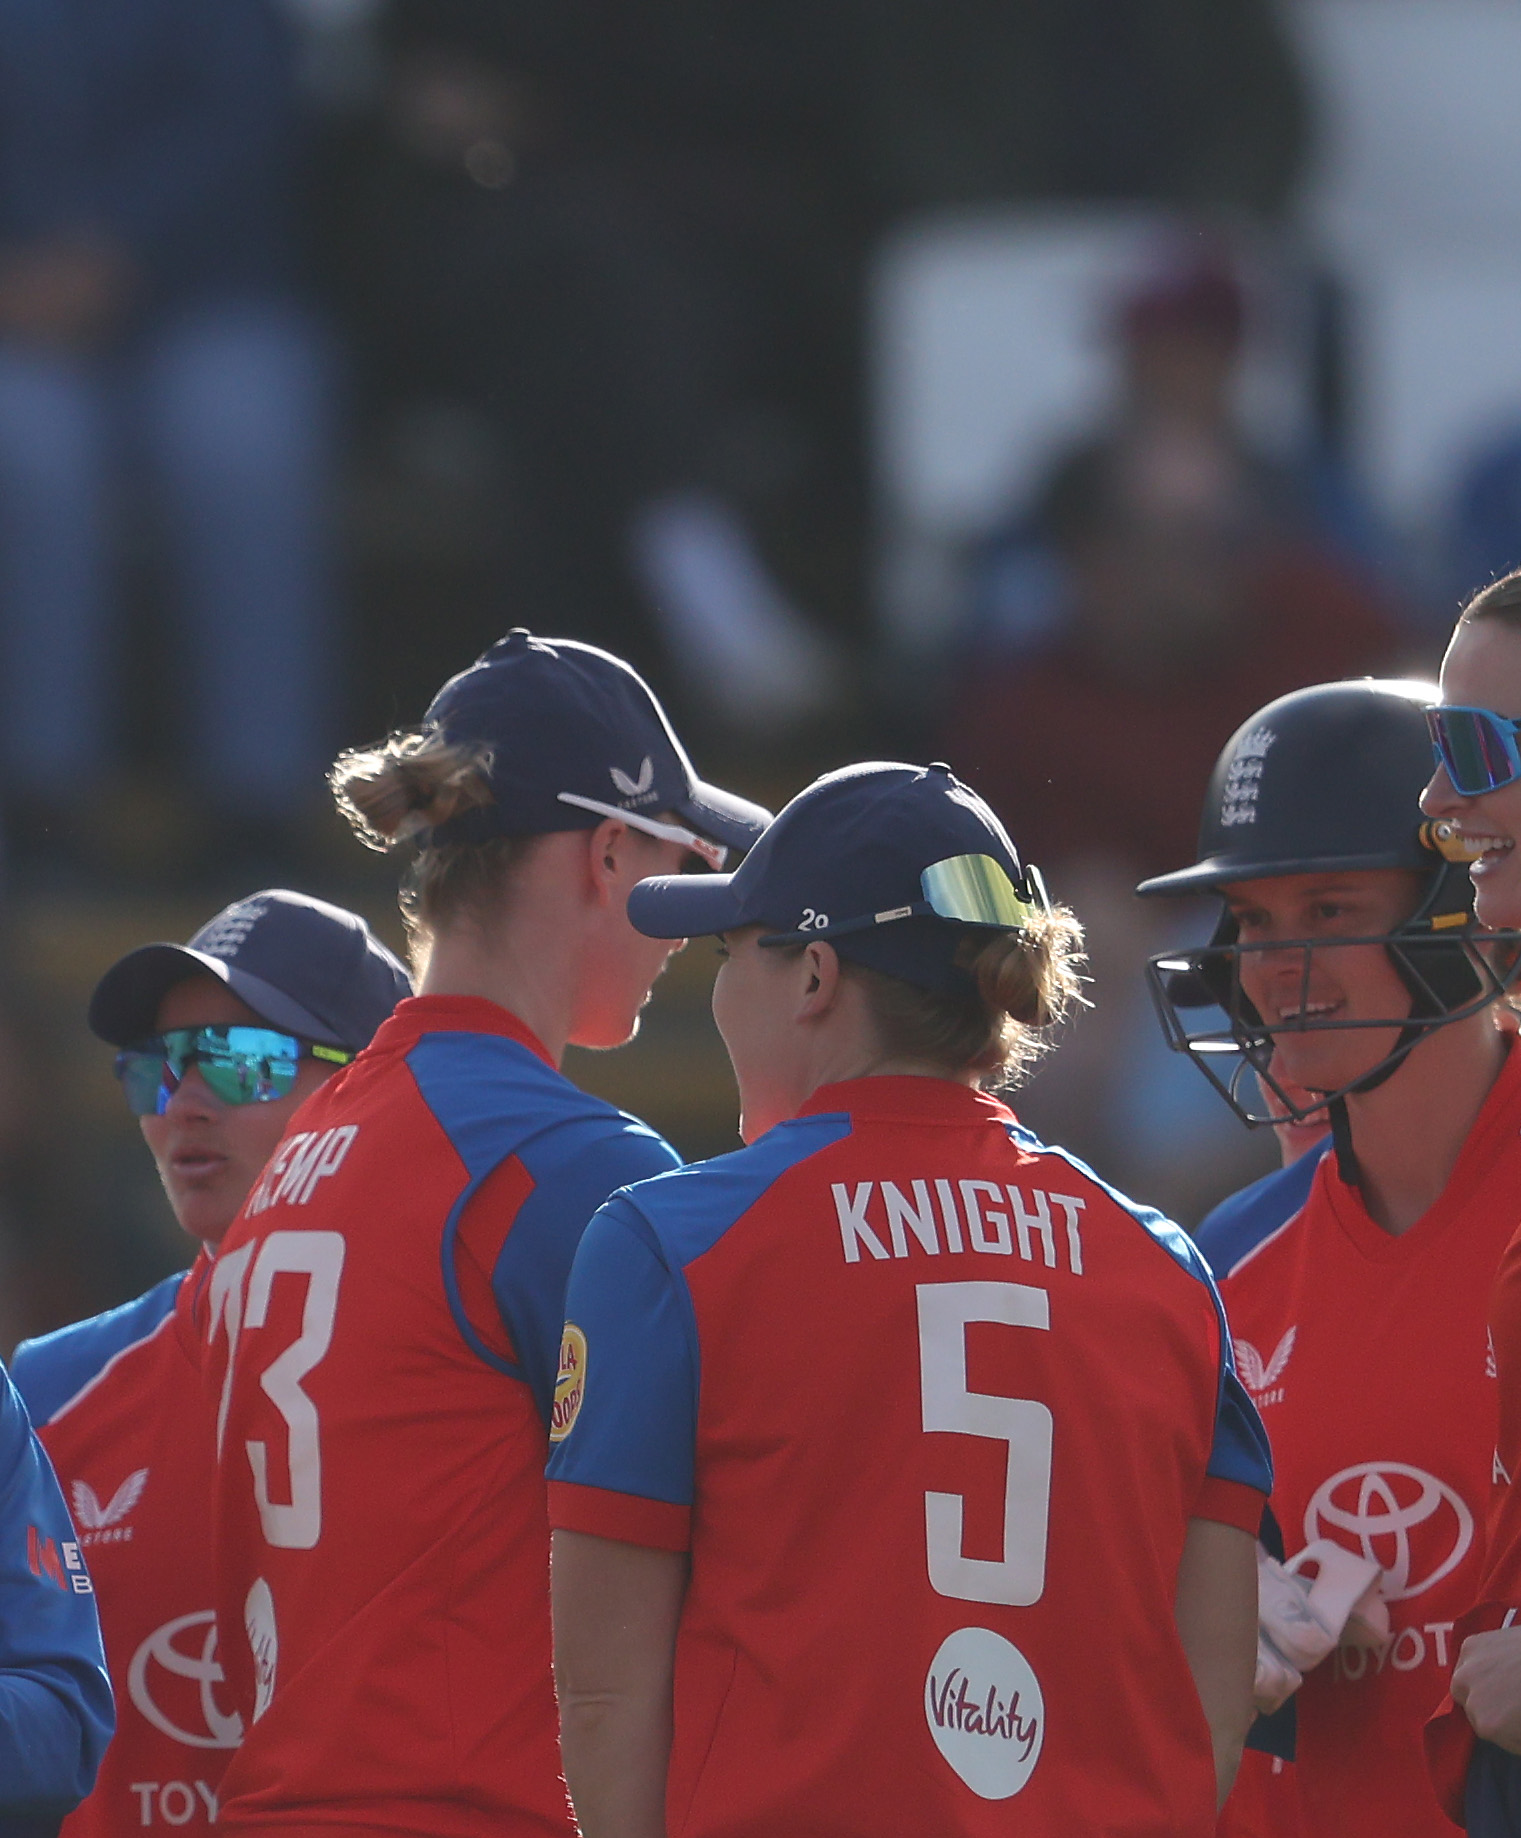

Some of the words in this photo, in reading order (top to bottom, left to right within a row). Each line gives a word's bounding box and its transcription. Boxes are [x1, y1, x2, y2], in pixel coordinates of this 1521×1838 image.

[831, 1179, 1086, 1276] KNIGHT
[207, 1230, 347, 1550] 73
[915, 1281, 1053, 1607] 5
[930, 1667, 1037, 1763] Vitality
[129, 1780, 219, 1827] TOY
